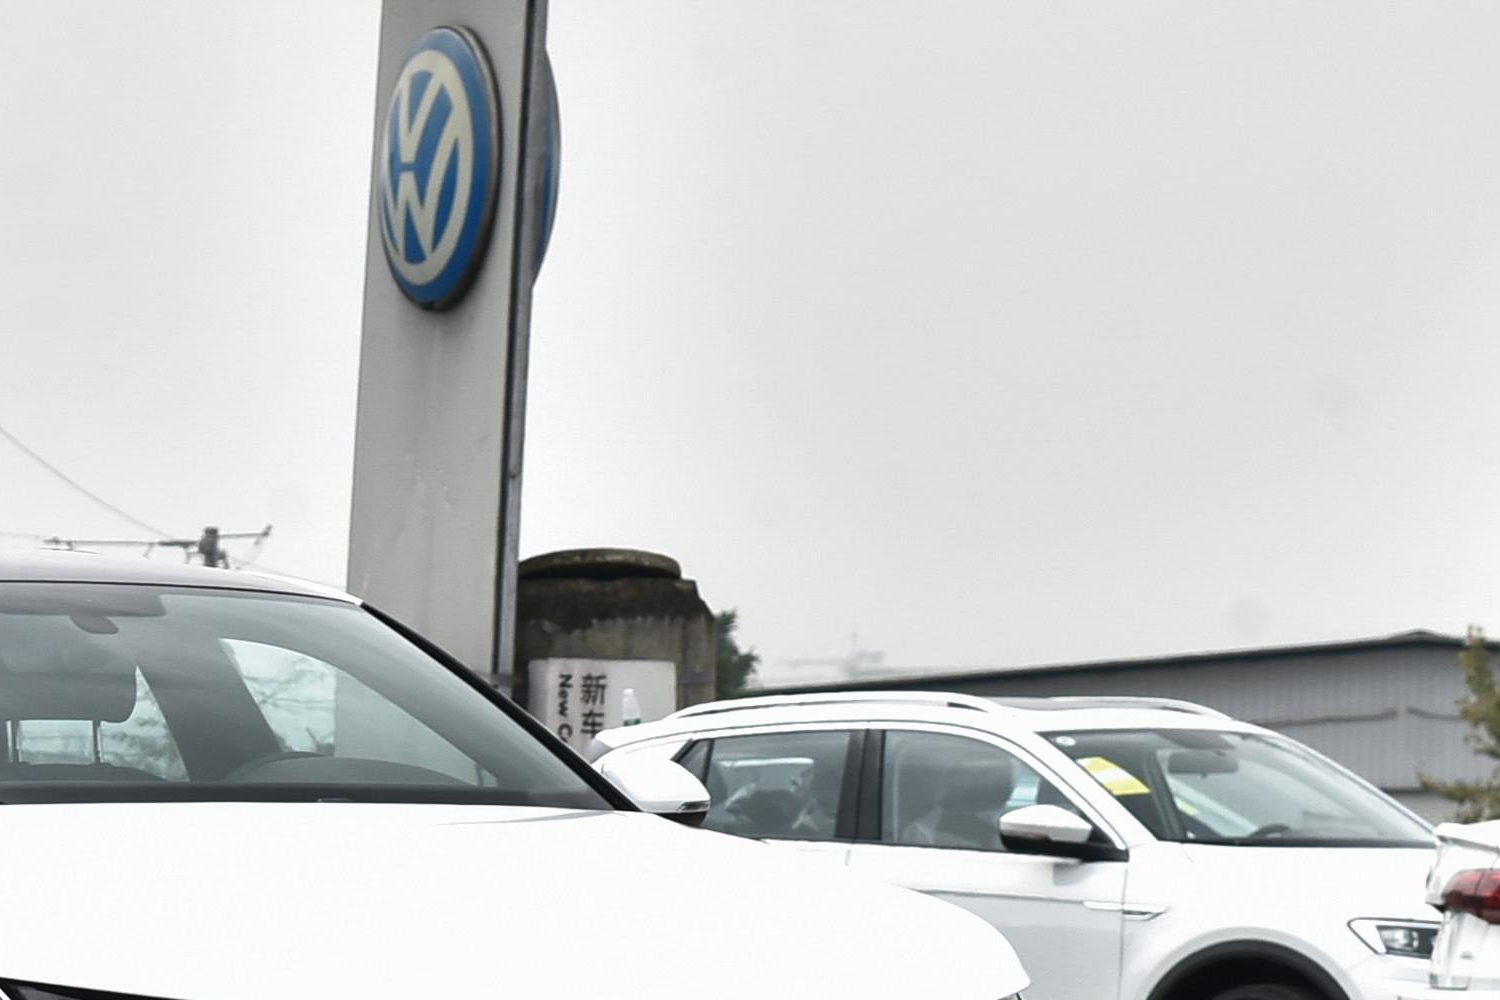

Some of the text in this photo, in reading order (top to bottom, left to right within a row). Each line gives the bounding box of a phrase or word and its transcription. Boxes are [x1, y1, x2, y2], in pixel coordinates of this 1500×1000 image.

[380, 48, 475, 287] VW
[558, 673, 573, 743] New C
[580, 673, 607, 739] 新车
